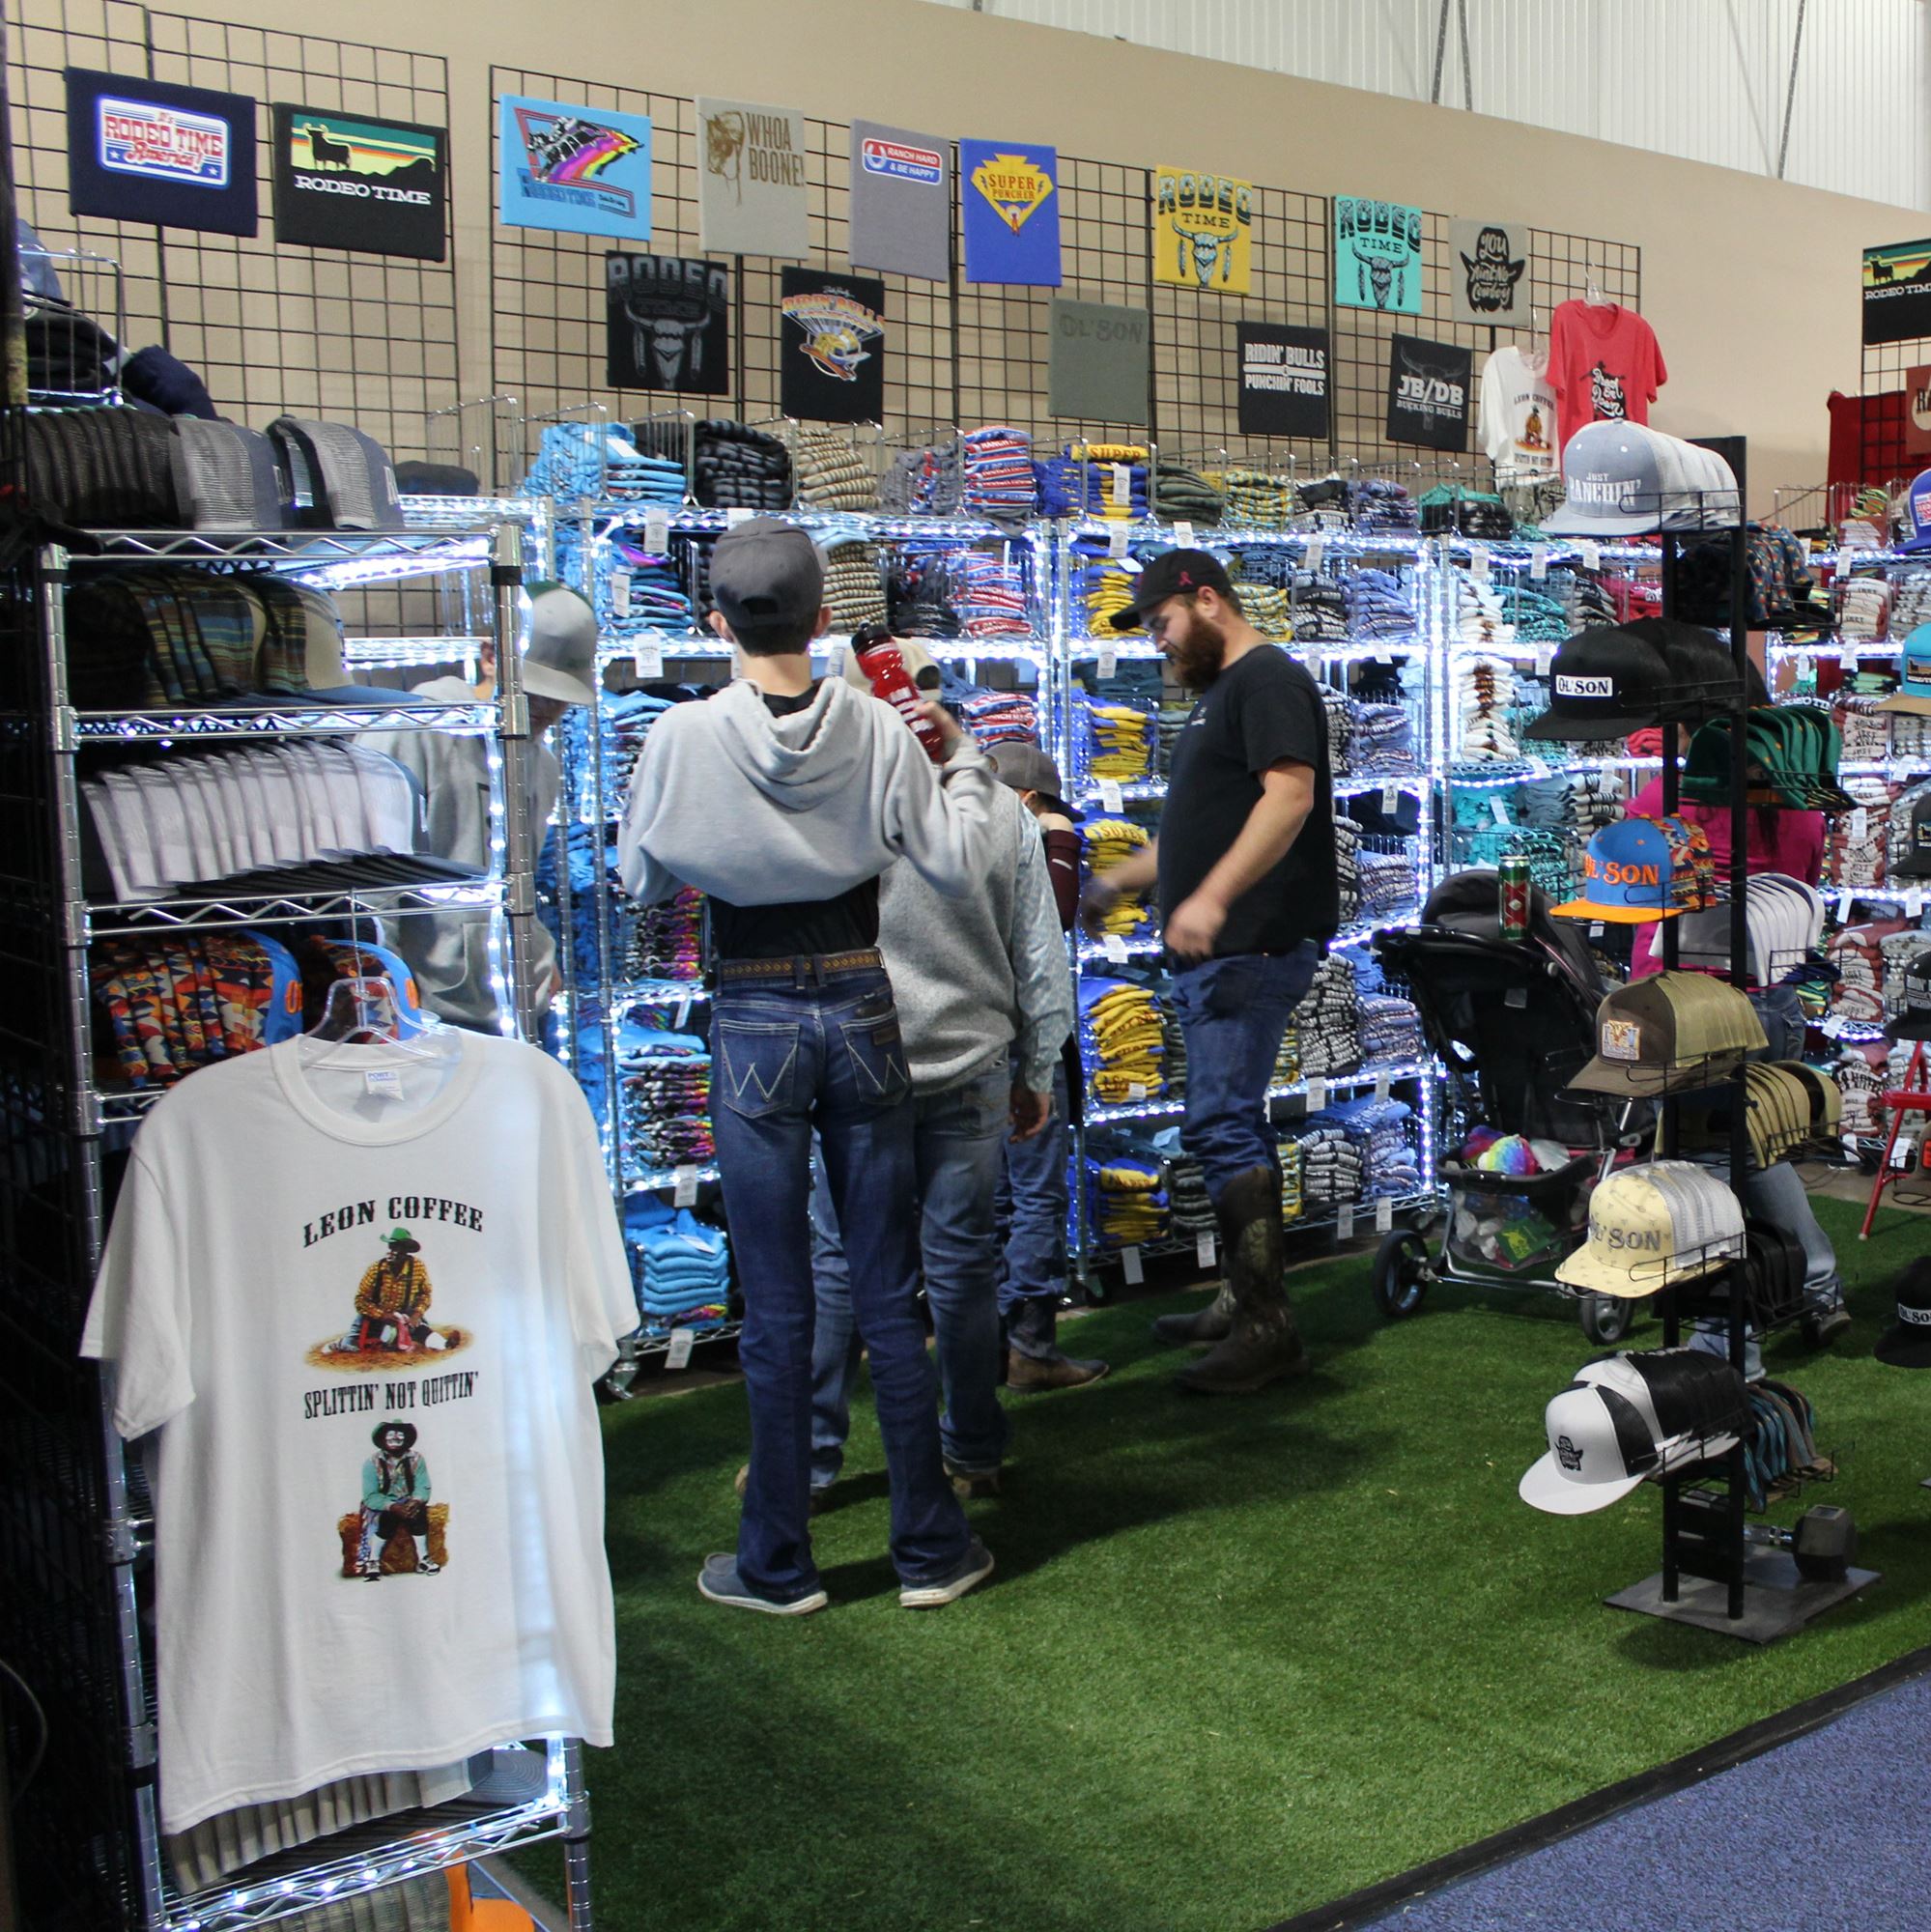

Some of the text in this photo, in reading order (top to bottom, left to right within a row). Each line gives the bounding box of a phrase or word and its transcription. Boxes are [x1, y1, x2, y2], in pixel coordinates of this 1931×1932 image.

[104, 115, 223, 157] RODEO TIME
[746, 112, 792, 152] WHOA
[887, 147, 938, 165] RANCH HARD
[889, 162, 935, 179] & BE HAPPY
[988, 174, 1036, 191] SUPER
[294, 175, 432, 205] RODEO TIME
[1158, 173, 1253, 226] RODEO
[1181, 213, 1231, 228] TIME
[1339, 200, 1422, 253] RODEO
[1360, 237, 1403, 254] TIME
[1864, 286, 1905, 299] RODEO
[1244, 343, 1325, 369] RIDIN' BULLS
[1244, 374, 1324, 396] PUNCHIN' FOOLS
[1397, 375, 1463, 406] JB/DB
[1396, 399, 1462, 419] BUCKING BULLS
[1586, 472, 1609, 481] JUST
[303, 1196, 484, 1247] LEON COFFEE
[304, 1372, 479, 1419] SPLITTIN' NOT QUITTIN'
